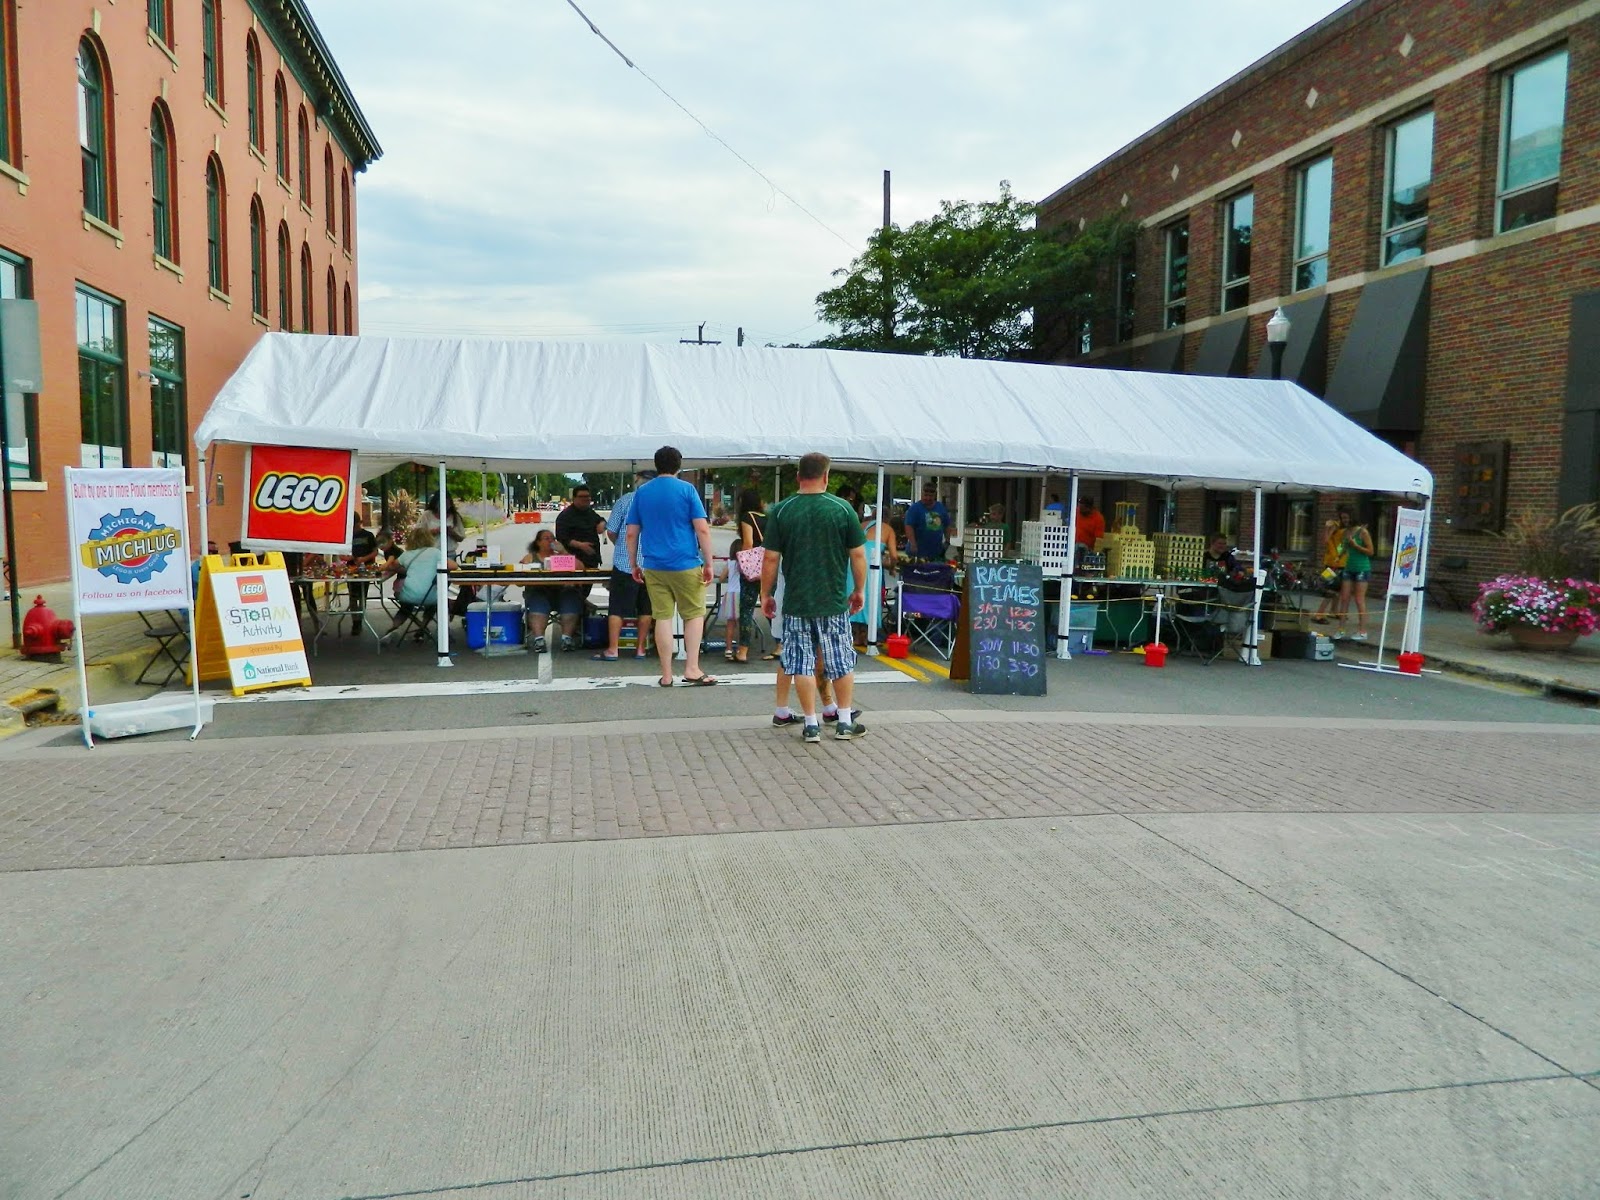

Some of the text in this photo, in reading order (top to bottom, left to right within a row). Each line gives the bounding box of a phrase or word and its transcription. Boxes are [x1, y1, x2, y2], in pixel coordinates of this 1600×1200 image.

[73, 483, 88, 498] Built
[96, 485, 107, 498] one
[115, 485, 130, 498] more
[130, 482, 146, 498] Proud
[147, 482, 173, 497] members
[254, 473, 343, 514] LEGO
[101, 517, 153, 537] MICHIGAN
[96, 533, 176, 565] MICHLUG
[975, 565, 1019, 585] RACE
[82, 591, 113, 600] Follow
[144, 588, 184, 598] facebook
[242, 584, 264, 596] LEGO
[974, 584, 1040, 606] TIMES
[978, 602, 1004, 615] SAT
[243, 623, 283, 638] Activity
[973, 615, 998, 631] 2:30
[1012, 641, 1040, 657] 11:30
[256, 663, 284, 676] National
[284, 661, 299, 672] Bank
[1008, 657, 1039, 677] 3:30
